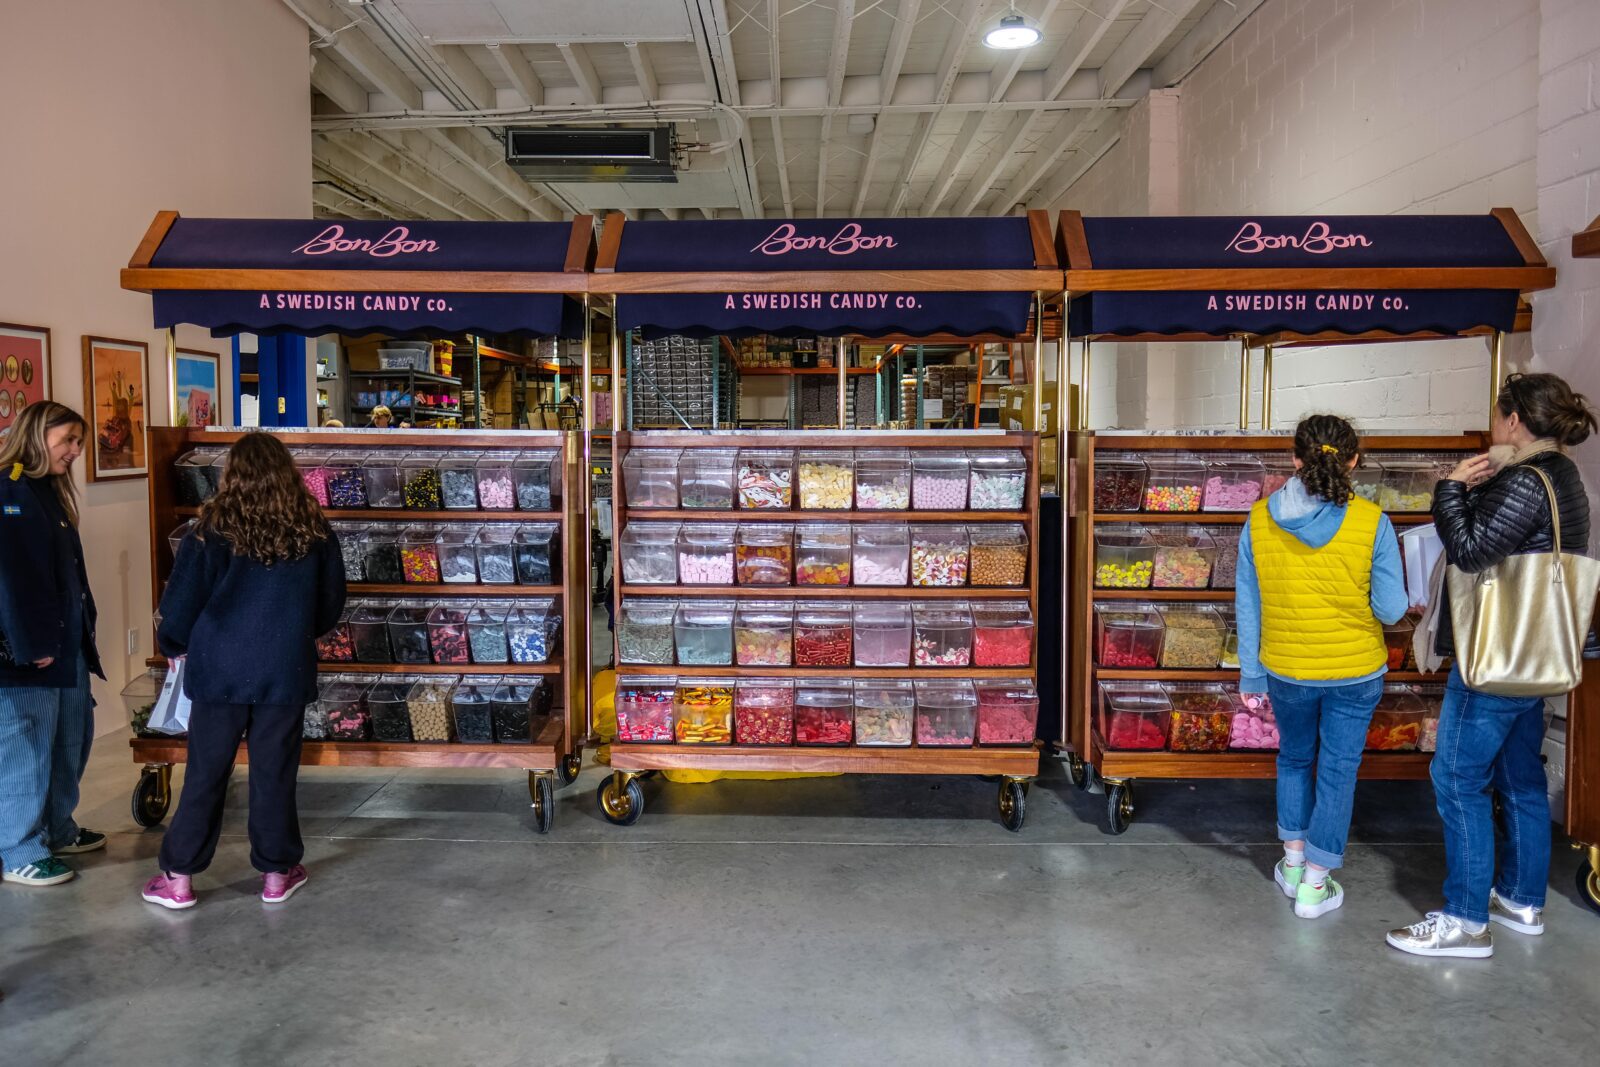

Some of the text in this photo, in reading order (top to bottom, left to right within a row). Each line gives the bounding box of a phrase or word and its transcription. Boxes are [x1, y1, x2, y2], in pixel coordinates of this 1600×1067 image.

[293, 224, 439, 258] BonBon
[750, 222, 899, 256] BonBon
[1224, 221, 1373, 254] BonBon
[259, 293, 271, 309] A
[276, 293, 356, 311] SWEDISH
[362, 294, 421, 312] CANDY
[724, 294, 736, 310] A
[742, 293, 822, 309] SWEDISH
[829, 293, 889, 309] CANDY
[1207, 295, 1218, 311] A
[1225, 294, 1307, 311] SWEDISH
[1315, 294, 1375, 311] CANDY
